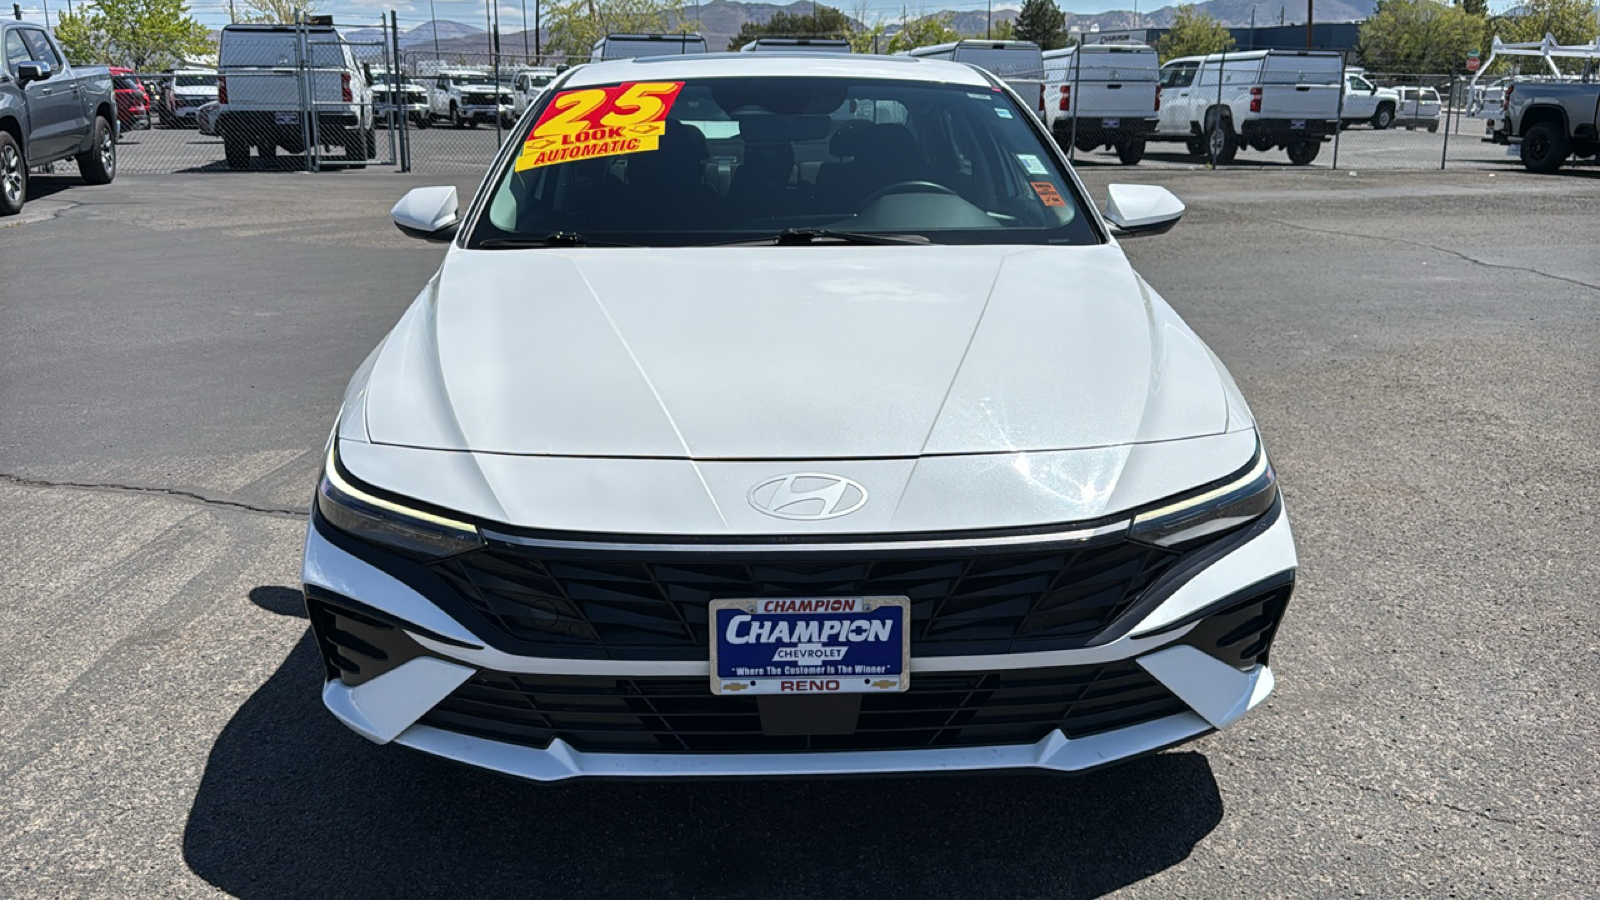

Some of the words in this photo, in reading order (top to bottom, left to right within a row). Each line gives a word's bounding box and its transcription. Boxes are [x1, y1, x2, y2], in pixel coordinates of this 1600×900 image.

[533, 82, 678, 137] 25
[561, 126, 626, 146] LOOK
[533, 138, 641, 165] AUTOMATIC
[763, 599, 856, 612] CHAMPION
[725, 614, 894, 645] CHAMPION
[777, 648, 842, 659] CHEVROLET
[766, 666, 782, 676] The
[784, 665, 826, 675] Customer
[826, 665, 836, 675] Is
[837, 665, 853, 674] The
[780, 679, 840, 691] RENO
